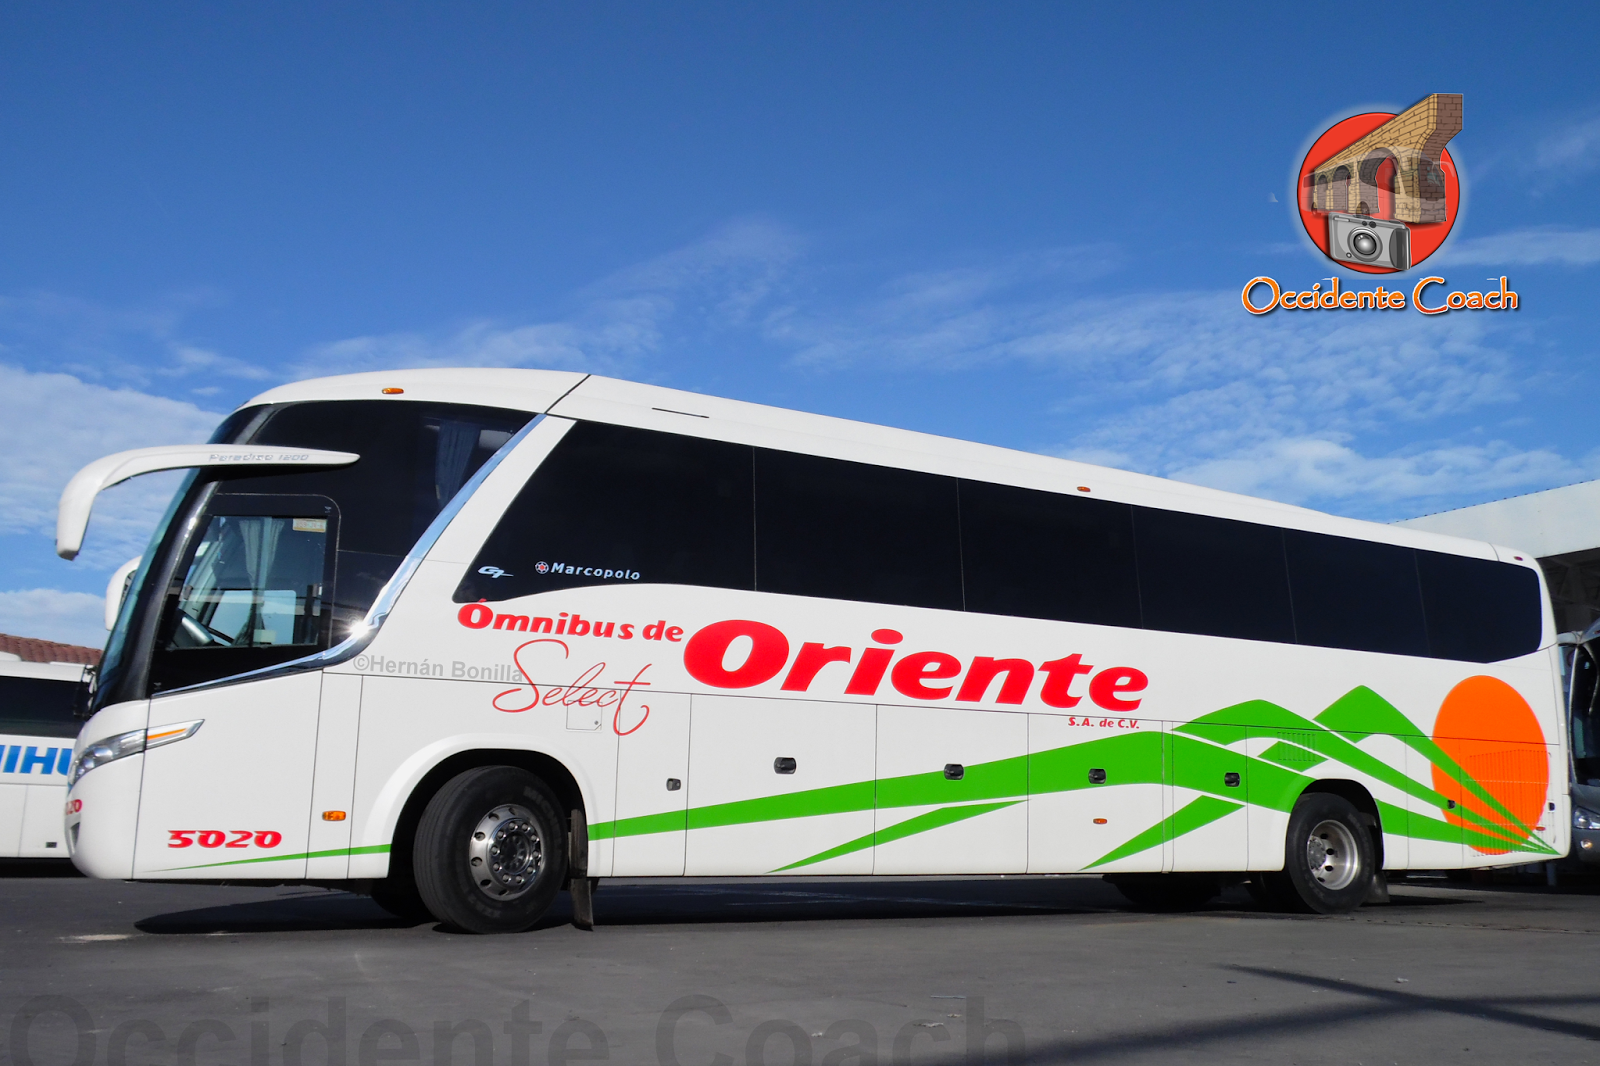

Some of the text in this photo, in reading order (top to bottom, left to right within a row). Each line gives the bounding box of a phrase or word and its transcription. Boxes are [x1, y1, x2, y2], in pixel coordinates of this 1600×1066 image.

[208, 453, 273, 462] Paradiso
[550, 562, 641, 580] Marcopolo
[457, 598, 1148, 712] Ómnibus de Oriente
[492, 638, 652, 736] Select
[1068, 716, 1140, 729] S.A. de C.V.
[167, 829, 282, 849] 5020
